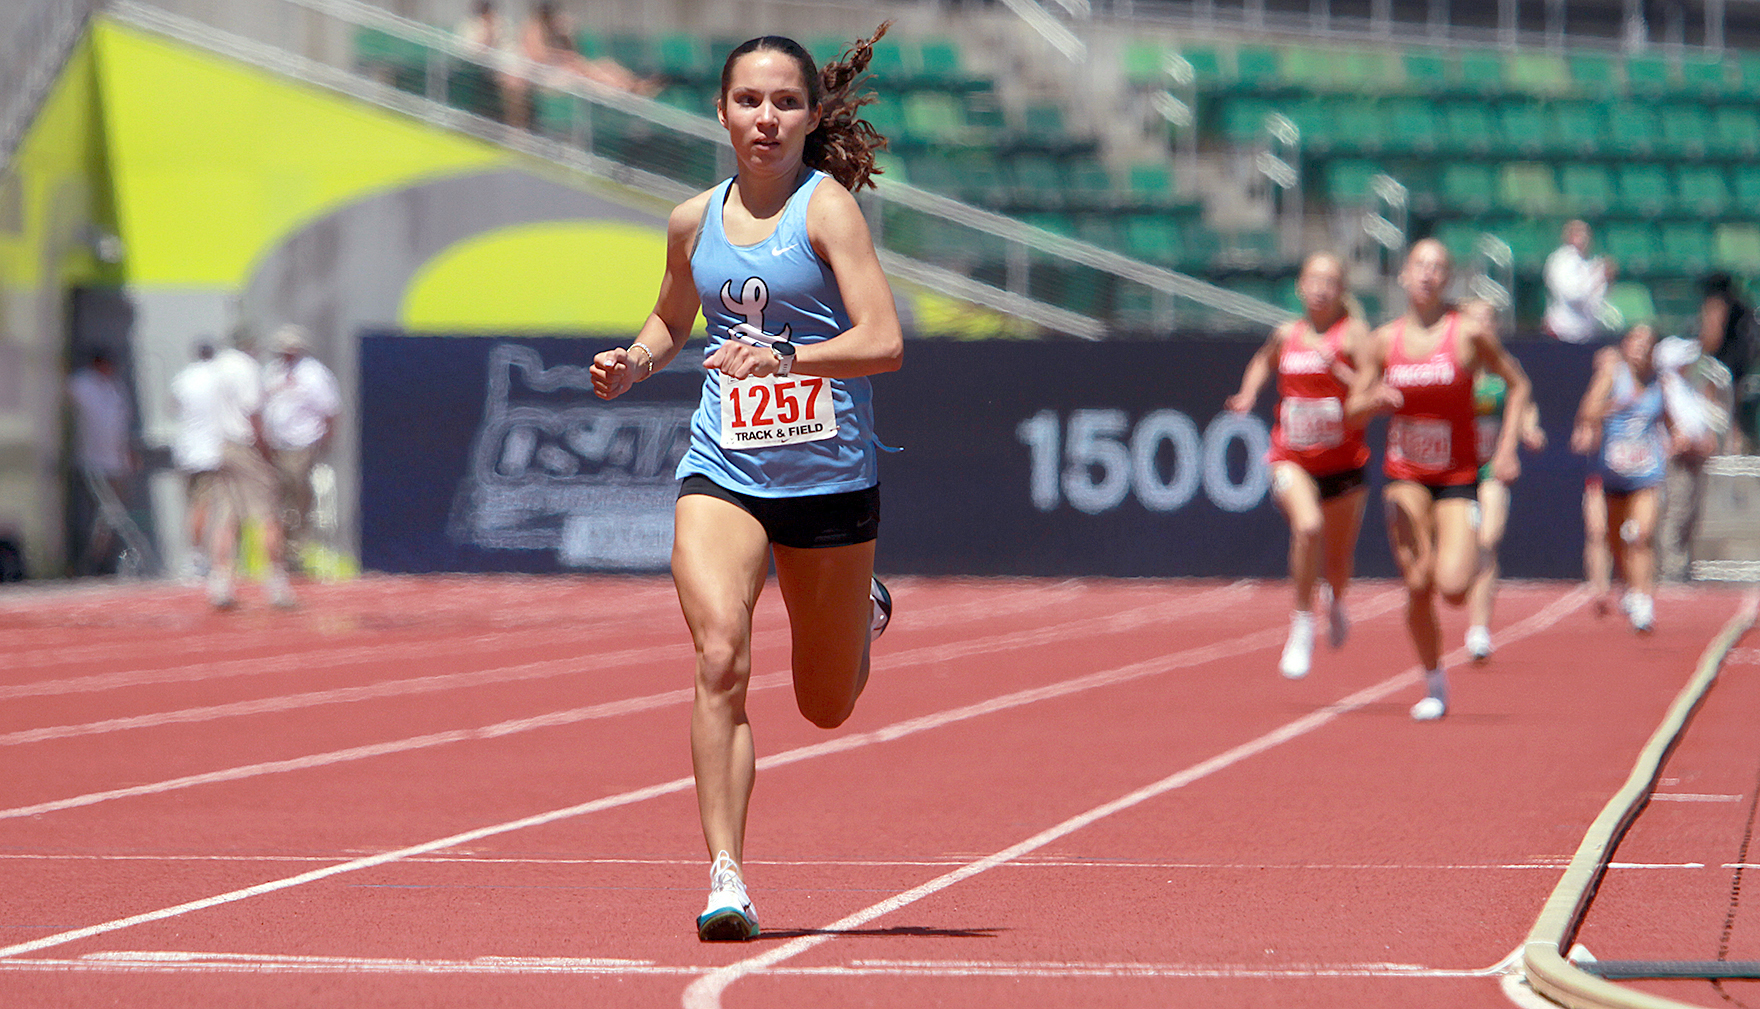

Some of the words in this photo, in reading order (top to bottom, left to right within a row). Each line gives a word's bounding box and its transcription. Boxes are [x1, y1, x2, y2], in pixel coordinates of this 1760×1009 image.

[729, 377, 823, 428] 1257
[735, 429, 773, 441] TRACK
[776, 428, 786, 438] &
[788, 423, 824, 437] FIELD
[1015, 408, 1272, 514] 1500
